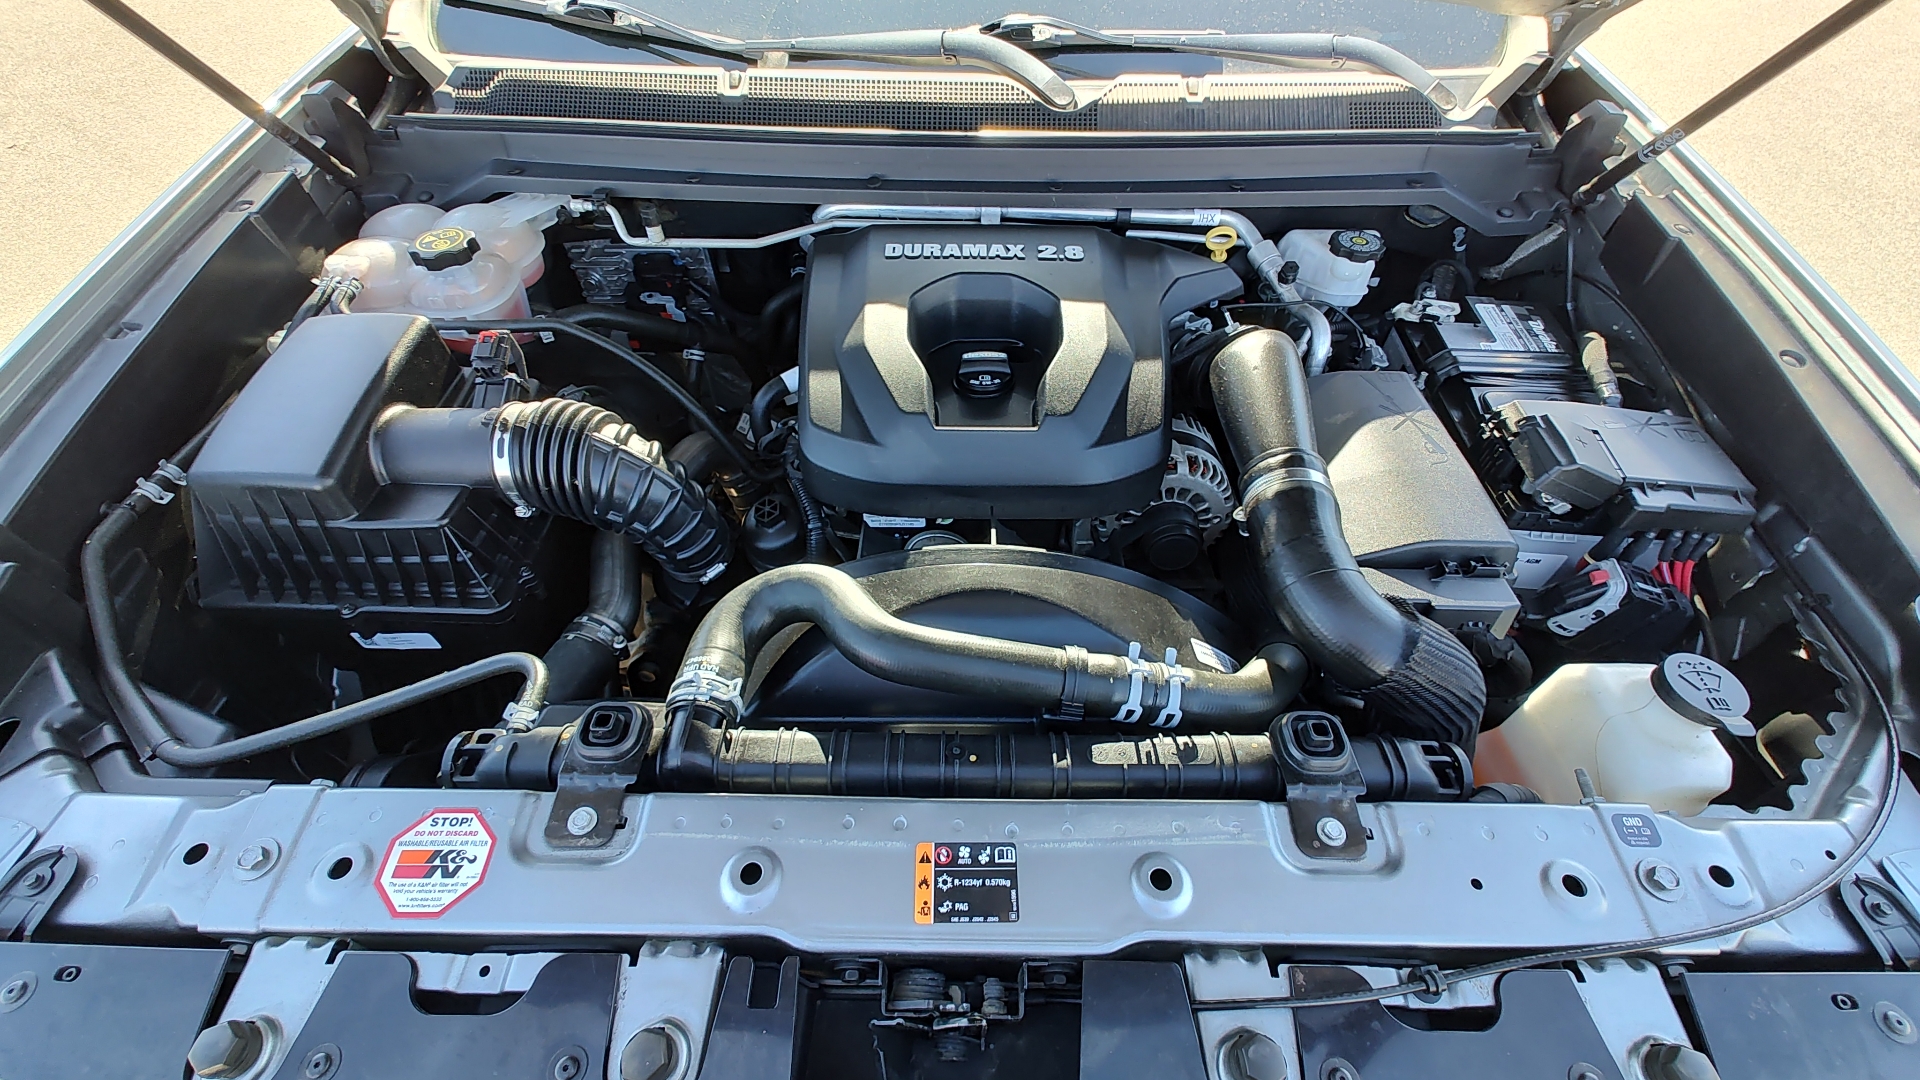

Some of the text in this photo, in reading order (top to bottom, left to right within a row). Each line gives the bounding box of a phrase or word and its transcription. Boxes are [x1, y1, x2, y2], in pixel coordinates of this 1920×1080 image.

[884, 243, 1084, 261] DURAMAX 2.8
[430, 817, 473, 827] STOP!
[1622, 816, 1643, 826] GND
[953, 878, 1011, 888] R-1234yf 0.570kg
[954, 902, 969, 911] PAG
